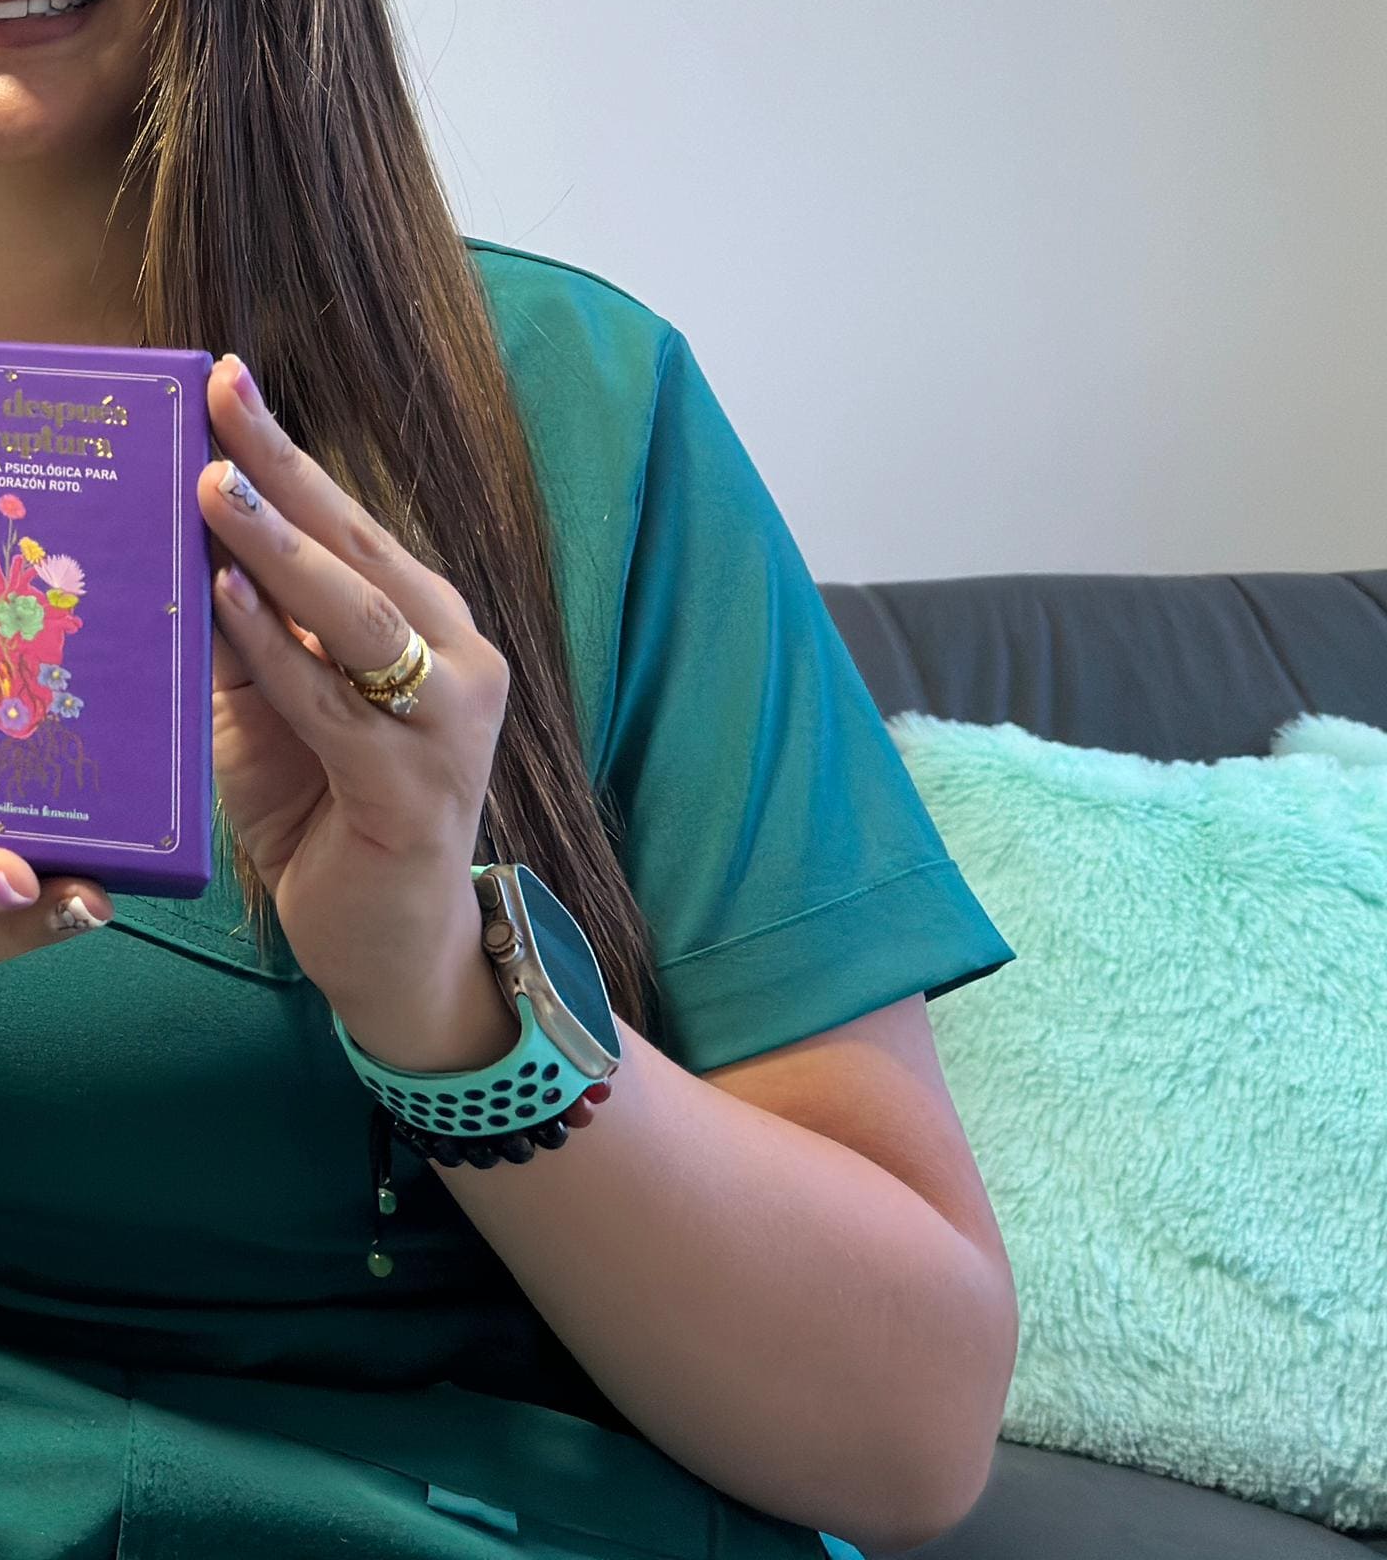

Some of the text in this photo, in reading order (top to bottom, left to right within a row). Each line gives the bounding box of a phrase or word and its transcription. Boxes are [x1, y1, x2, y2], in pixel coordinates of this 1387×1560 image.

[3, 388, 128, 428] después
[5, 461, 82, 479] PSICOLÓGICA
[85, 468, 118, 481] PARA
[49, 480, 83, 493] ROTO.
